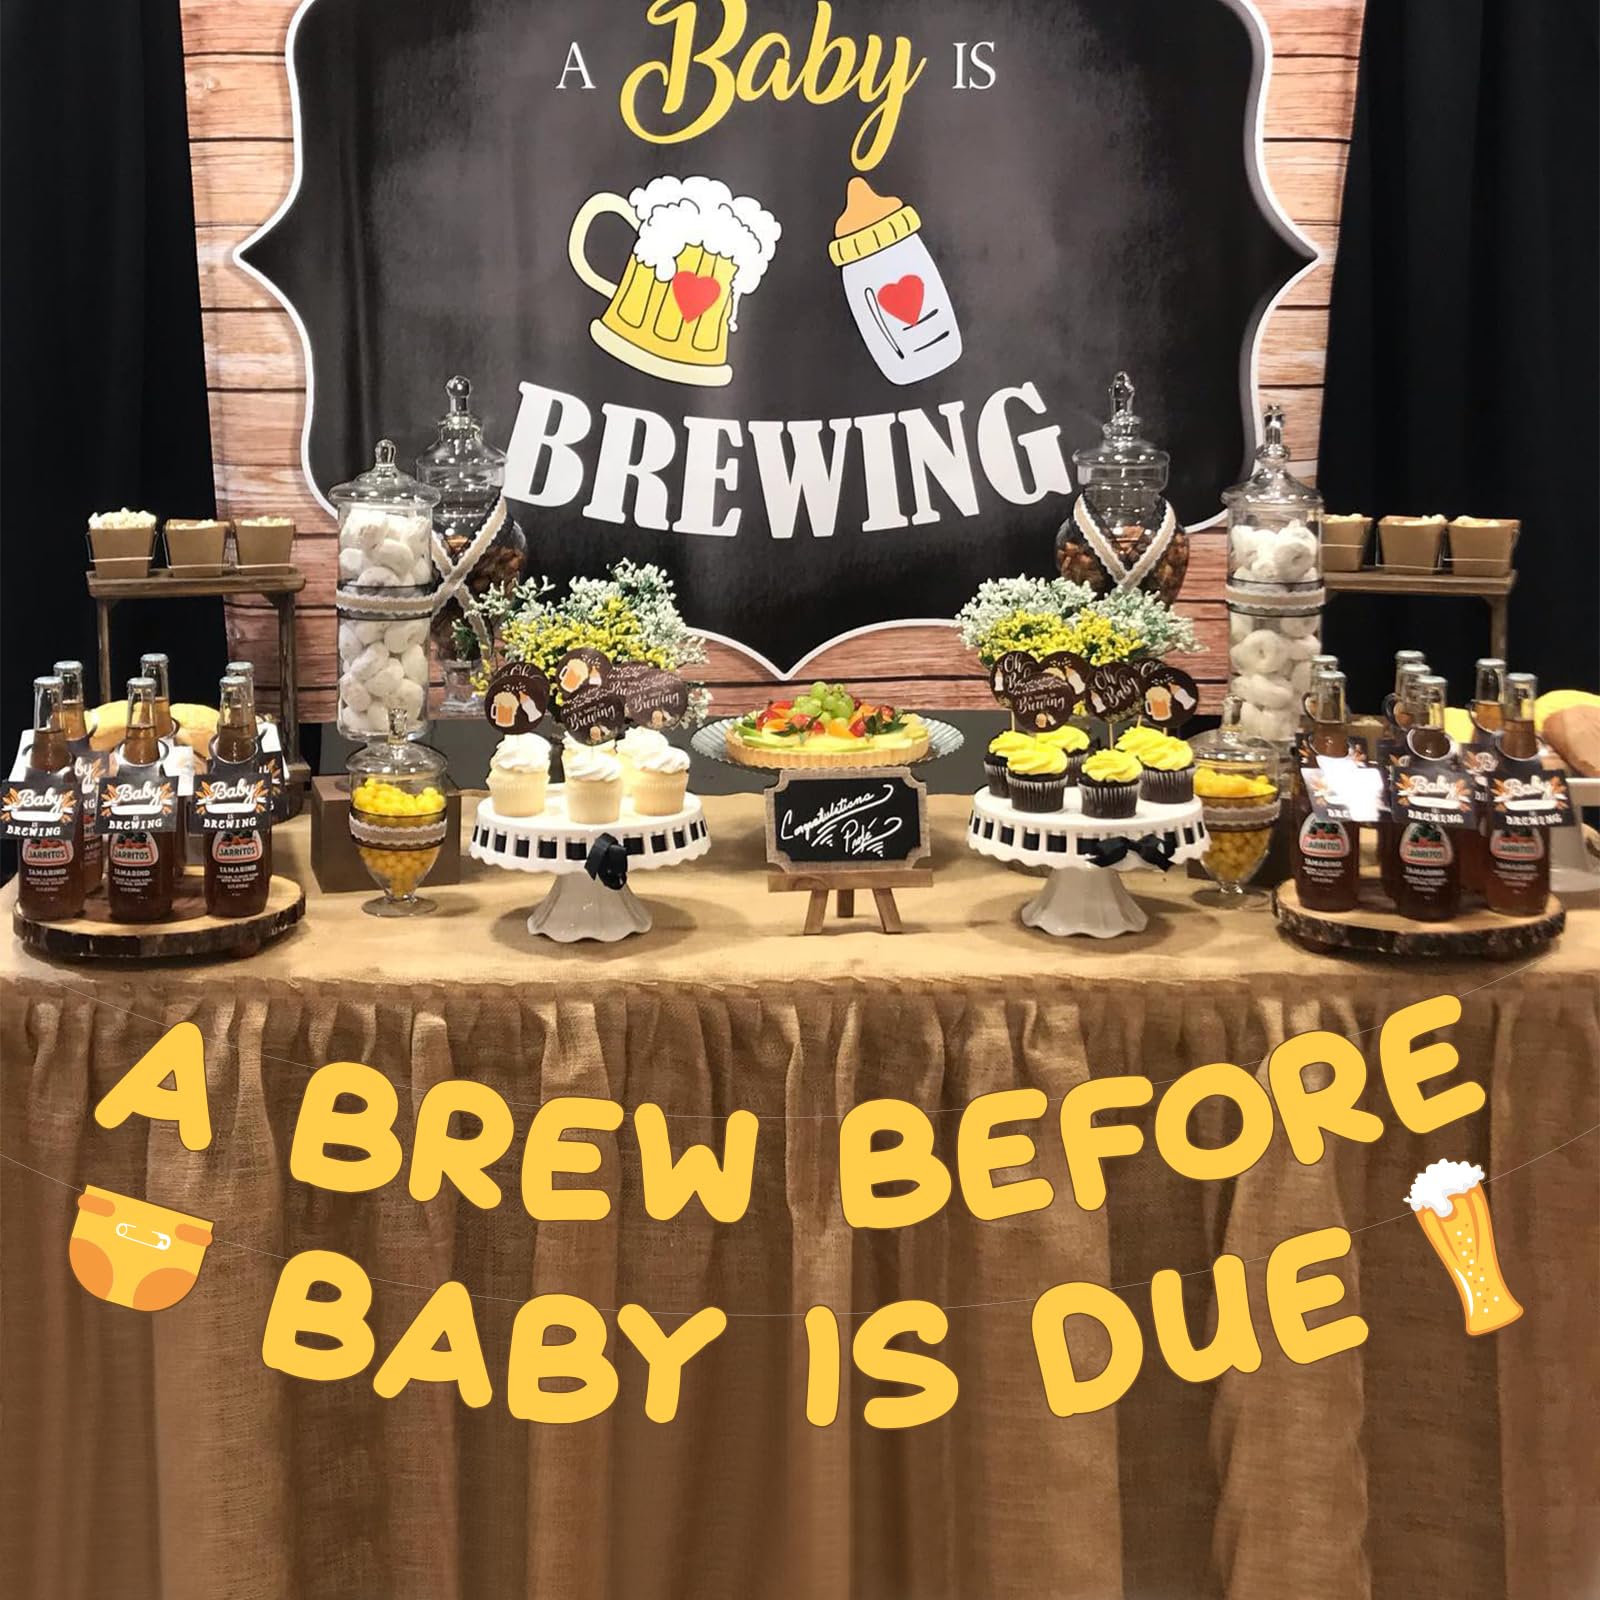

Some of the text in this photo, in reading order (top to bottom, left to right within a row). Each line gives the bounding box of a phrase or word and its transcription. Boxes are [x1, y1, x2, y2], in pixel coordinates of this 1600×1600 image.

[555, 0, 997, 171] A Baby IS
[502, 381, 1073, 539] BREWING
[17, 787, 65, 814] Baby
[115, 781, 162, 807] Baby
[209, 778, 256, 805] Baby
[6, 825, 61, 837] BREWING
[108, 818, 163, 831] BREWING
[203, 817, 257, 829] BREWING
[95, 994, 1486, 1230] A BREW BEFORE
[262, 1226, 1369, 1429] BABY IS DUE
